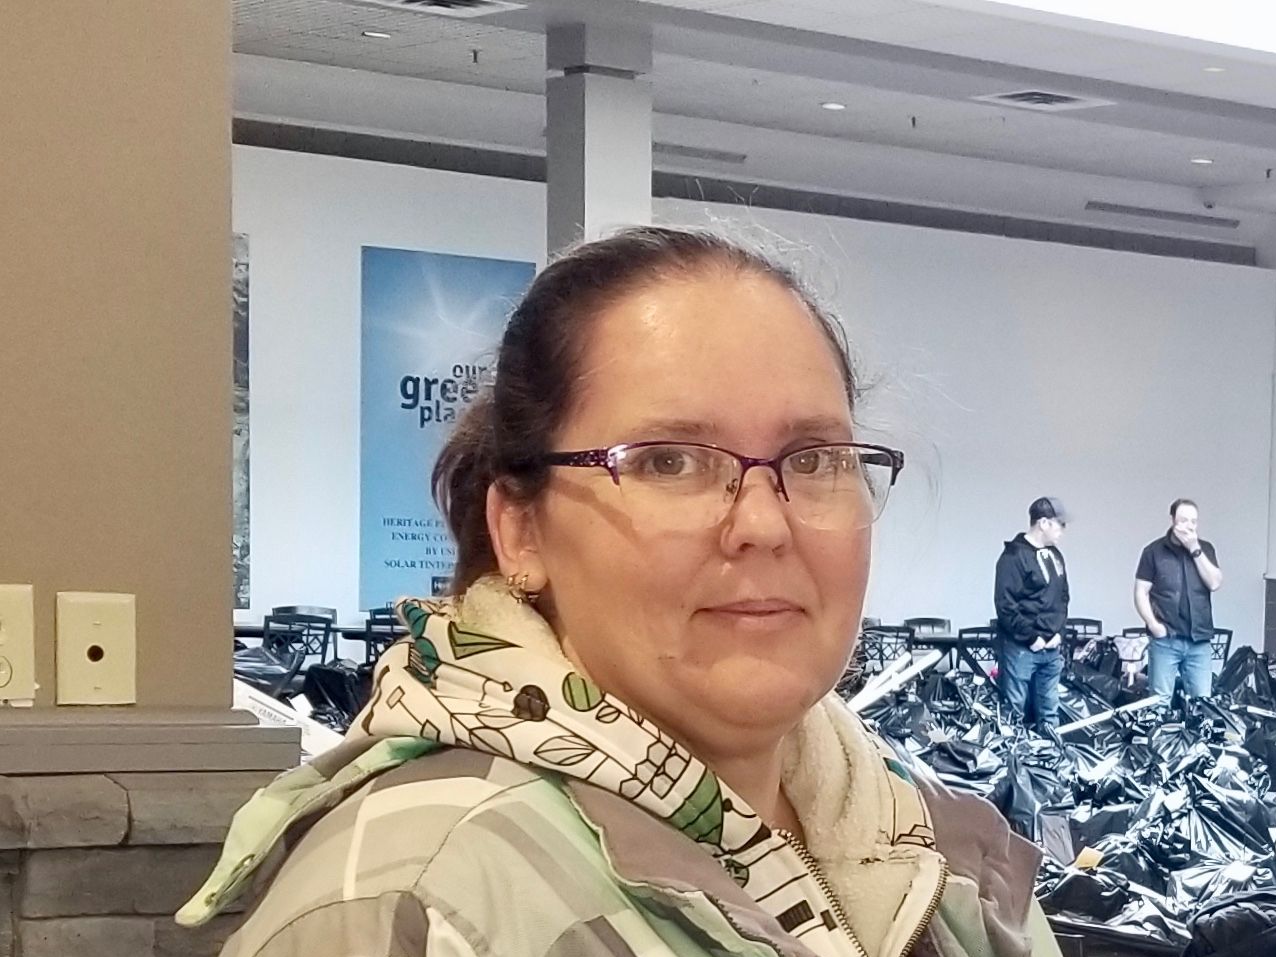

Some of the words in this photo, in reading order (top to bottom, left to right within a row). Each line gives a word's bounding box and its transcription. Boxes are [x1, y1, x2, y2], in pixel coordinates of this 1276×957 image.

[452, 364, 487, 380] our
[400, 375, 479, 410] gree
[420, 399, 456, 428] pla
[382, 517, 433, 528] HERITAGE
[391, 531, 430, 542] ENERGY
[384, 559, 417, 569] SOLAR
